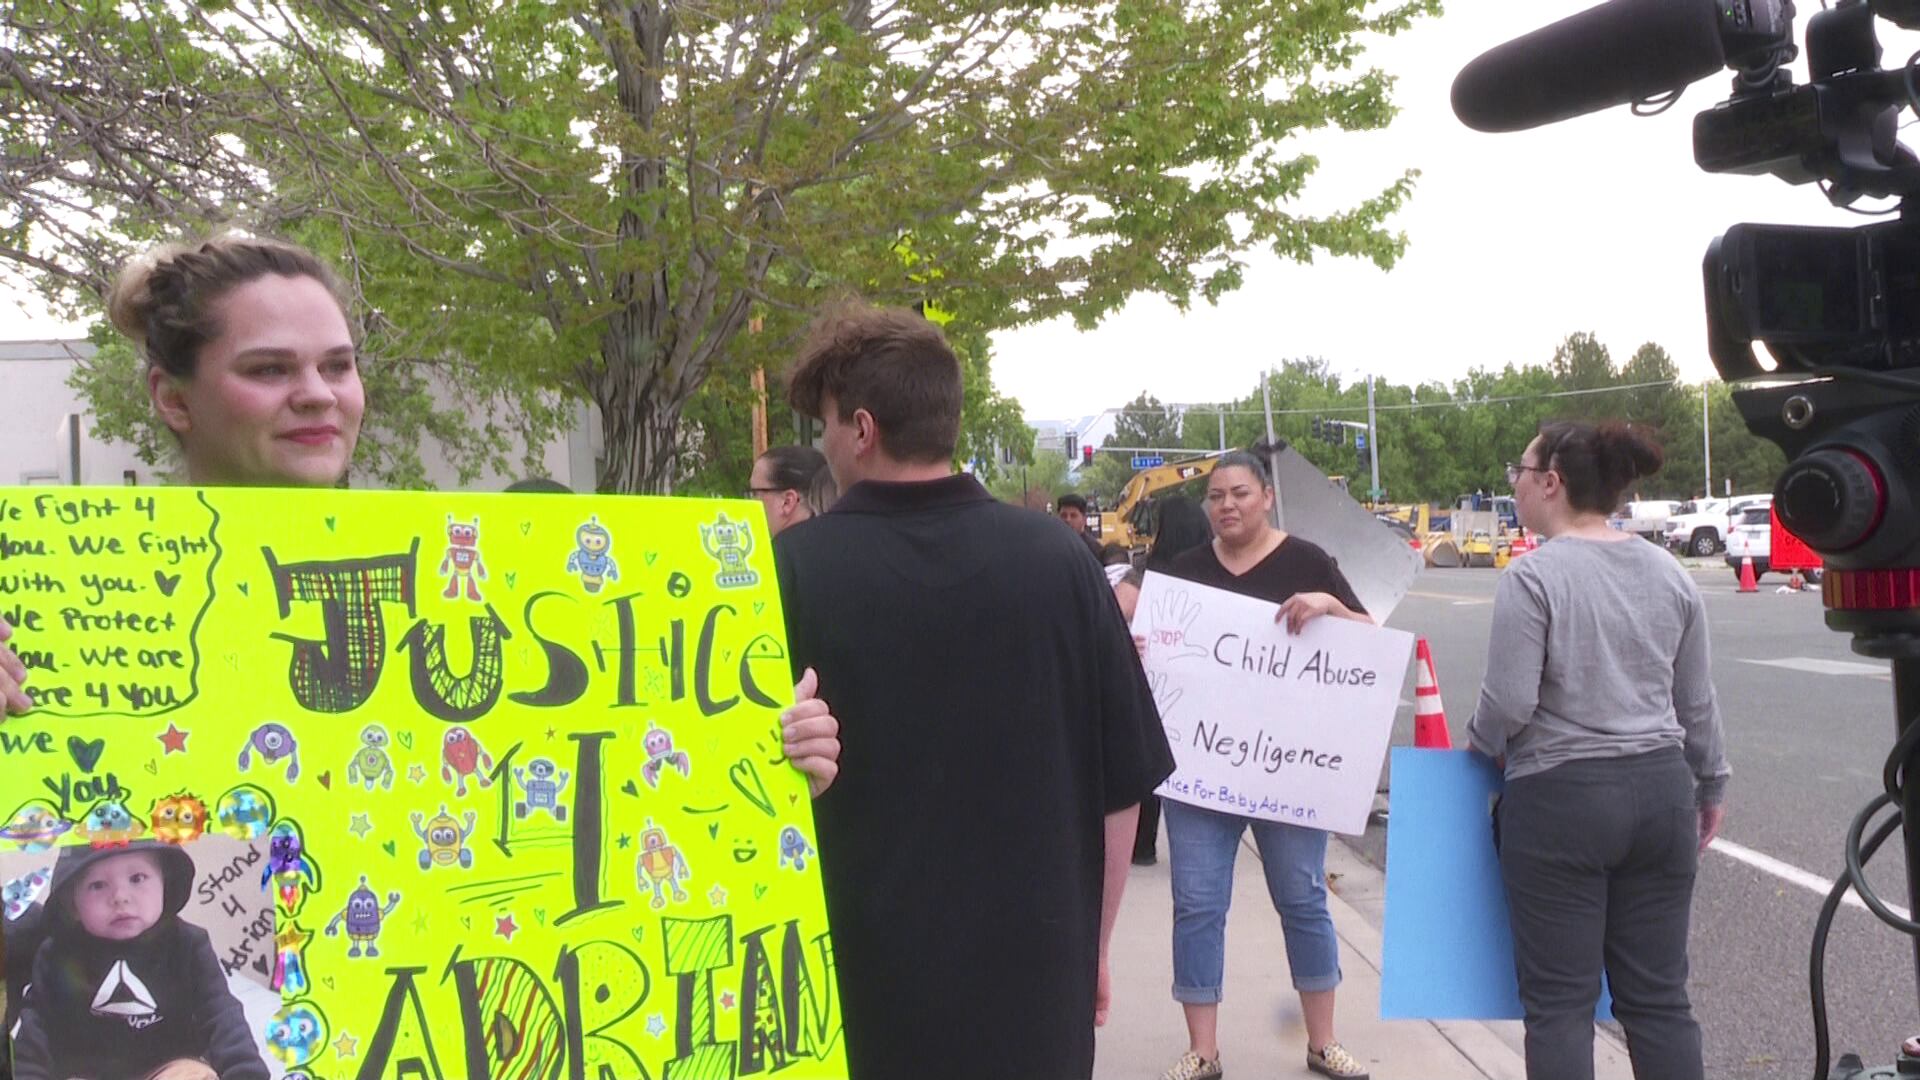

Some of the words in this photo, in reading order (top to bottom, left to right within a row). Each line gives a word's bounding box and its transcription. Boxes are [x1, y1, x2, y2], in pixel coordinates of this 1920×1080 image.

[0, 499, 22, 521] e
[135, 496, 155, 522] 4
[1151, 629, 1184, 648] STOP
[9, 643, 70, 673] ou.
[137, 649, 185, 668] are
[1213, 633, 1292, 679] Child
[1297, 649, 1377, 686] Abuse
[25, 686, 74, 708] ere
[85, 682, 109, 708] 4
[1193, 719, 1344, 773] Negligence
[198, 843, 261, 905] Stand
[222, 894, 247, 917] 4
[220, 908, 276, 977] Adrian
